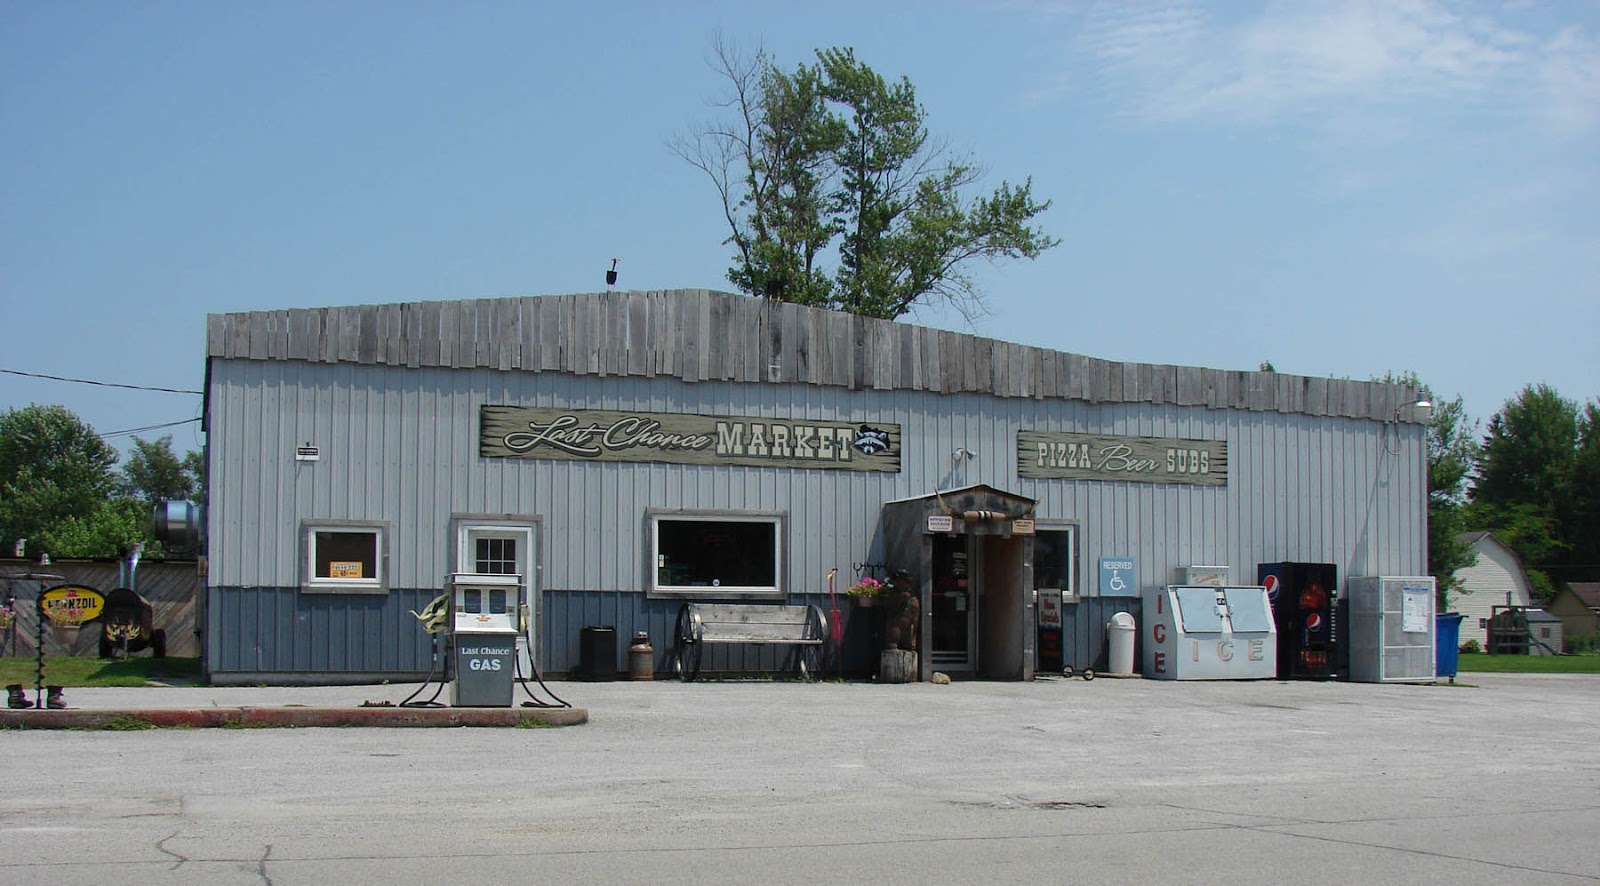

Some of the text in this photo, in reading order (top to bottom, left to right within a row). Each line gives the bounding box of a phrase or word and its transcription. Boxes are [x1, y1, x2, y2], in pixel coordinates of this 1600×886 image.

[503, 415, 854, 461] Last Chance MARKET
[1037, 442, 1210, 474] PIZZA Beer SUBS
[1103, 561, 1133, 570] RESERVED
[1153, 594, 1166, 674] ICE
[462, 647, 510, 655] Last Chance
[1192, 640, 1264, 662] ICE
[469, 659, 502, 671] GAS
